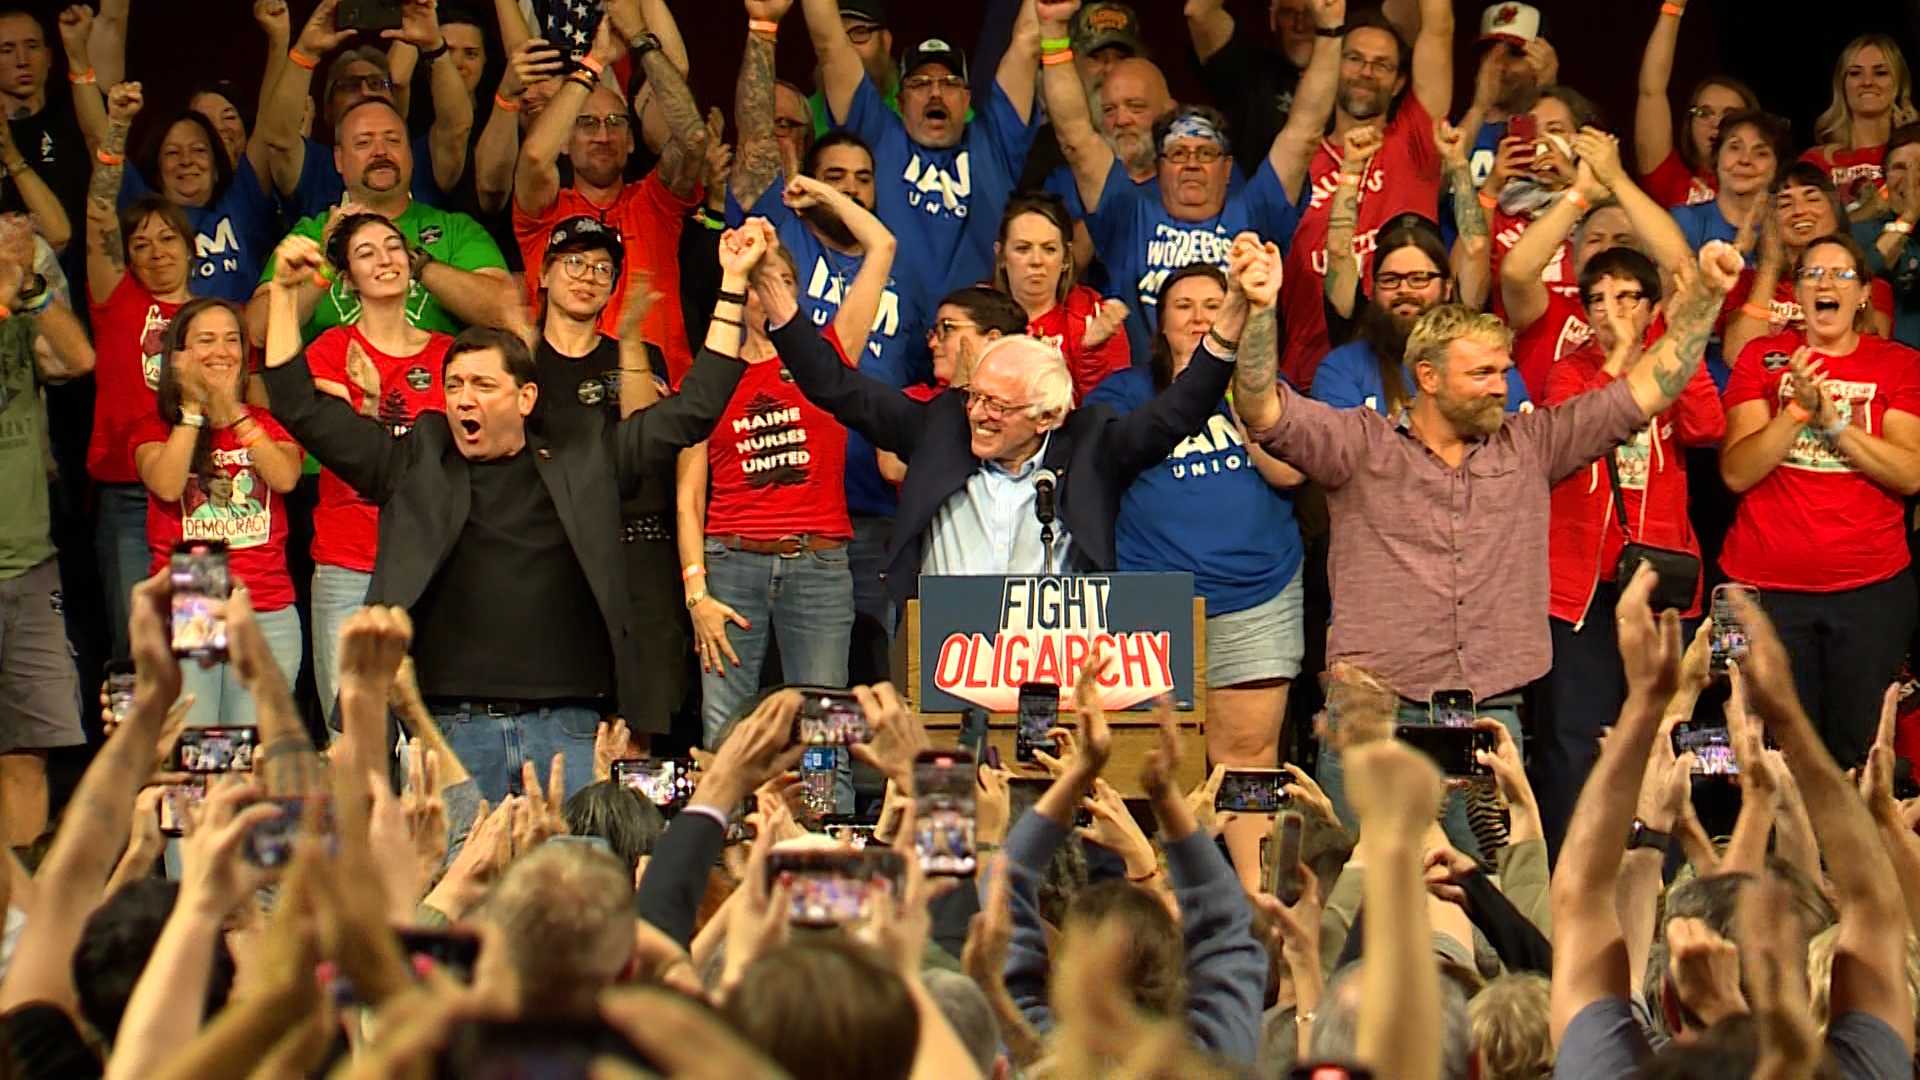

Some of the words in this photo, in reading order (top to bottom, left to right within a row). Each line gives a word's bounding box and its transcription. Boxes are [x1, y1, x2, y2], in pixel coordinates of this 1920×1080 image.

[732, 407, 800, 433] MAINE
[736, 429, 806, 454] NURSES
[742, 451, 810, 473] UNITED
[1173, 455, 1251, 478] UNIO
[185, 515, 267, 536] DEMOCRACY
[1002, 578, 1109, 630] FIGHT
[935, 632, 1174, 689] OLIGARCHY
